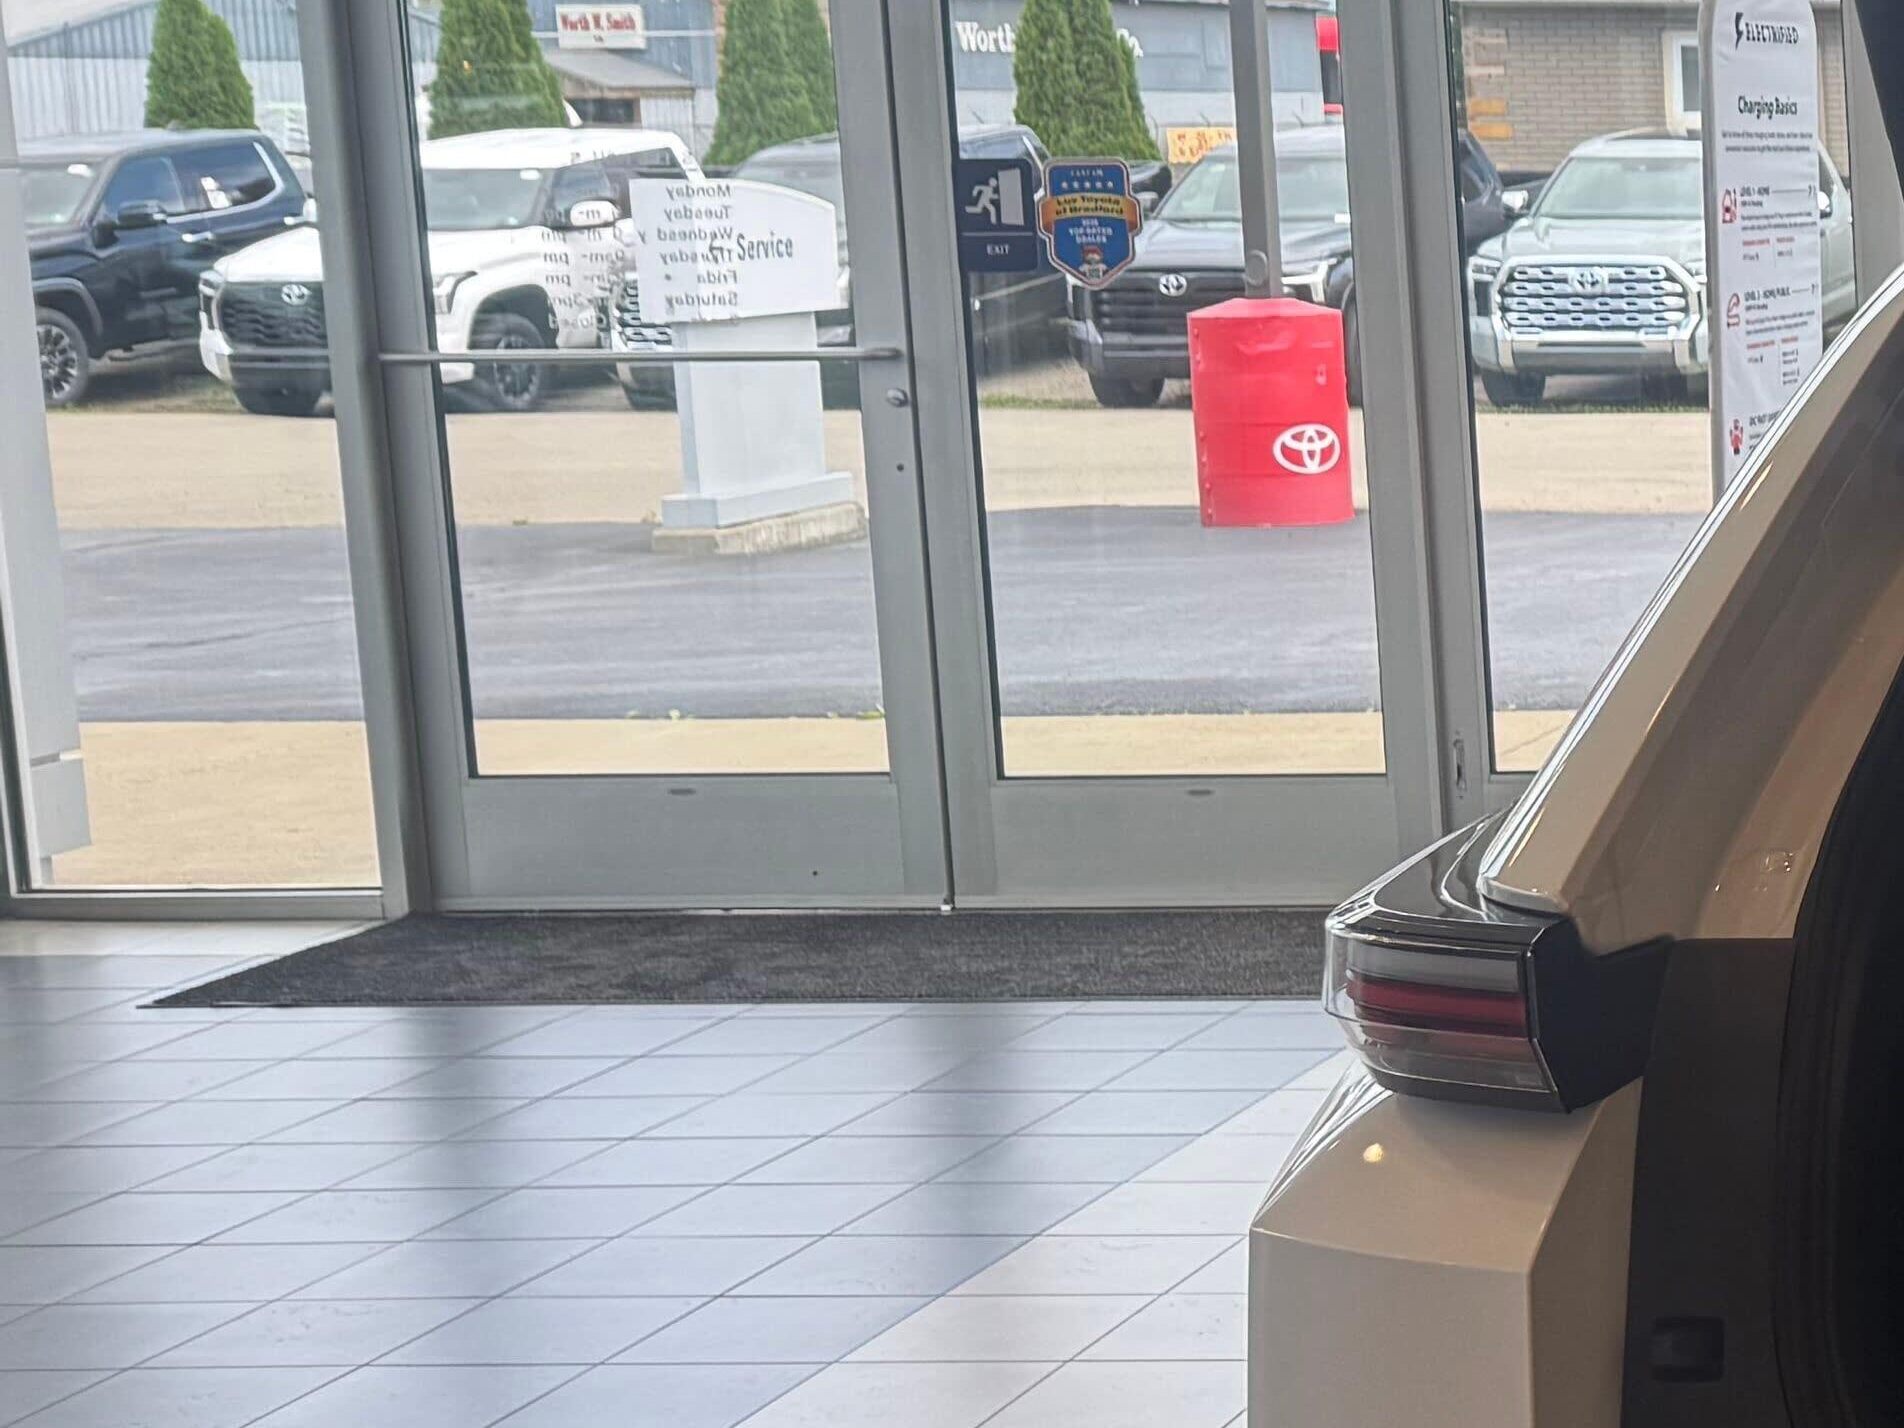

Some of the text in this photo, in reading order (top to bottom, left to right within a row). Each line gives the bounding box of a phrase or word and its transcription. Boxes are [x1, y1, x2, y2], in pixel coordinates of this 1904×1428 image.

[1746, 22, 1799, 44] ELECTRIFIED
[1738, 95, 1798, 120] Charging Basics
[736, 231, 794, 260] Service
[986, 243, 1011, 256] EXIT
